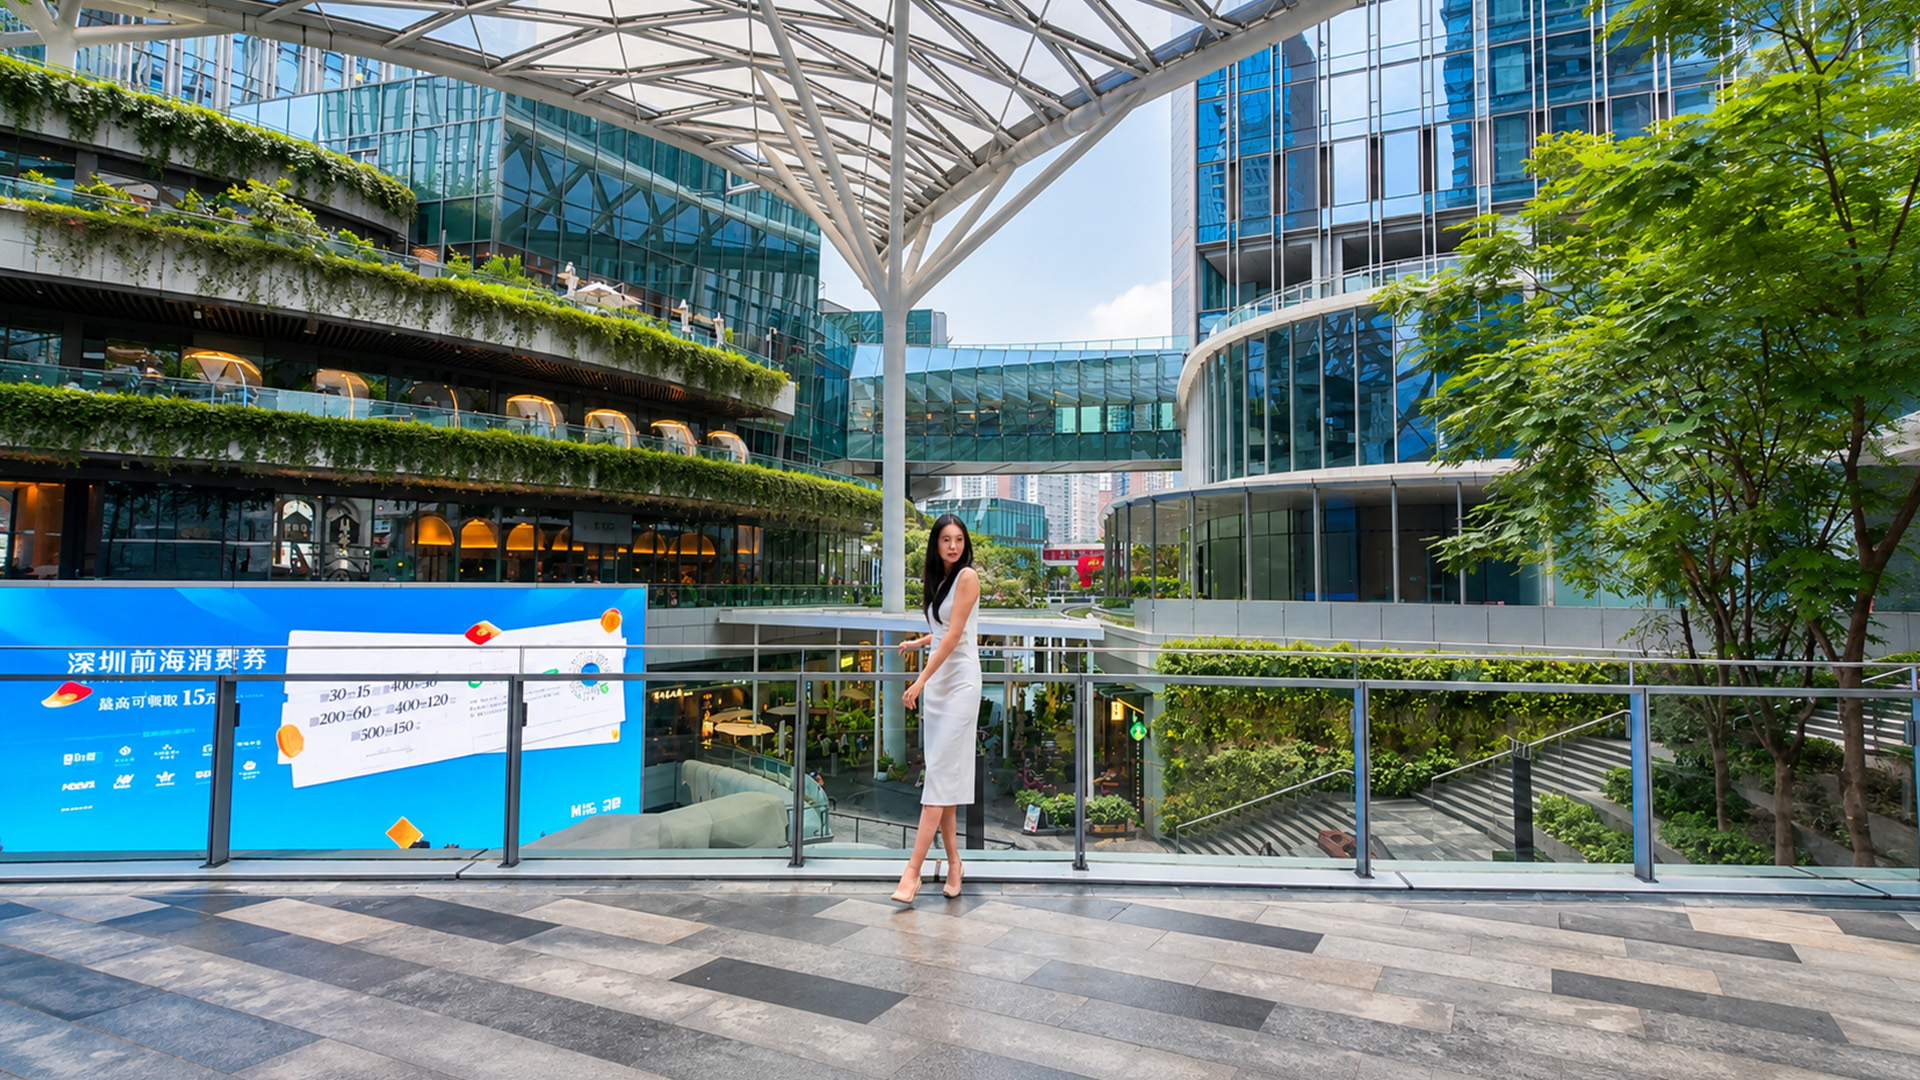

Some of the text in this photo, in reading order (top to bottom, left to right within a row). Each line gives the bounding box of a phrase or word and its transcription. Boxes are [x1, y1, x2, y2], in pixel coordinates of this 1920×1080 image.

[67, 648, 267, 674] 深圳前海消费券
